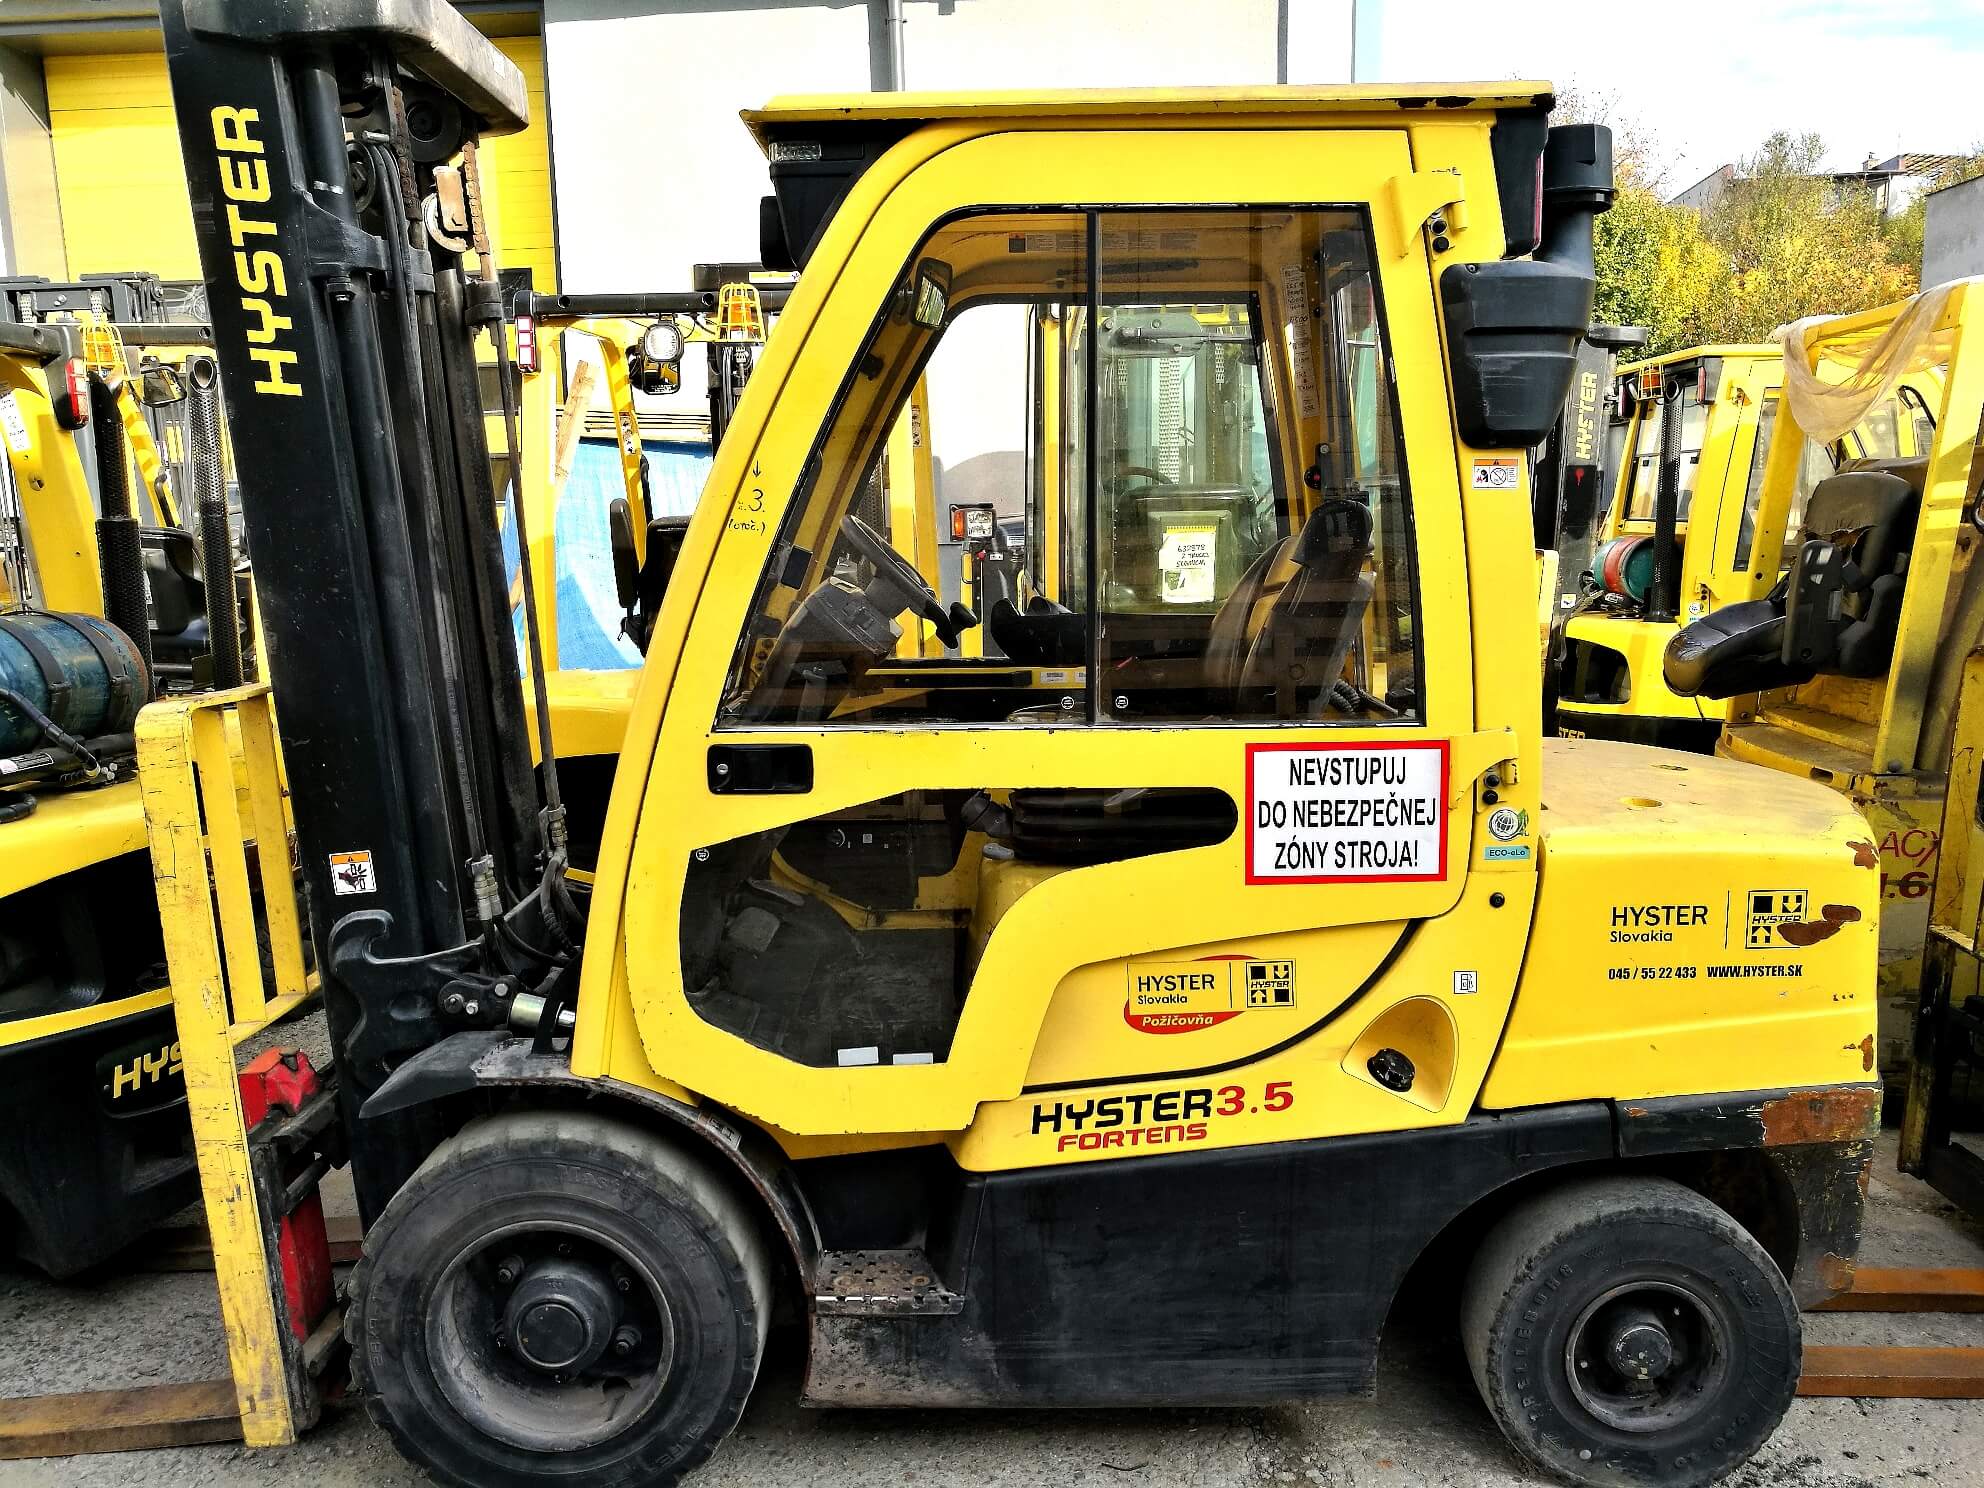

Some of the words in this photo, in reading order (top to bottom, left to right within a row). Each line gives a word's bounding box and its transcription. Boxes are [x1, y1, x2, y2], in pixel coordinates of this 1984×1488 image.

[210, 105, 303, 396] HYSTER
[1575, 371, 1598, 460] HYSTER
[1289, 756, 1406, 786] NEVSTUPUJ
[1258, 800, 1287, 828] DO
[1293, 791, 1436, 828] NEBEZPEČNEJ
[1274, 834, 1329, 869] ZÓNY
[1334, 840, 1418, 869] STROJA!
[1611, 905, 1708, 926] HYSTER
[1751, 914, 1802, 924] HYSTER
[1610, 930, 1673, 943] Slovakia
[1137, 973, 1215, 992] HYSTER
[1608, 967, 1630, 980] 045
[1641, 967, 1656, 979] 55
[1658, 967, 1673, 979] 22
[1675, 966, 1697, 979] 433
[1707, 965, 1803, 979] WWW.HYSTER.SK
[1250, 980, 1290, 989] HYSTER
[1137, 994, 1188, 1005] Slovakia
[1142, 1014, 1214, 1027] Požičovňa
[1031, 1088, 1213, 1135] HYSTER
[1216, 1081, 1294, 1116] 3.5
[1057, 1122, 1208, 1152] FORTENS
